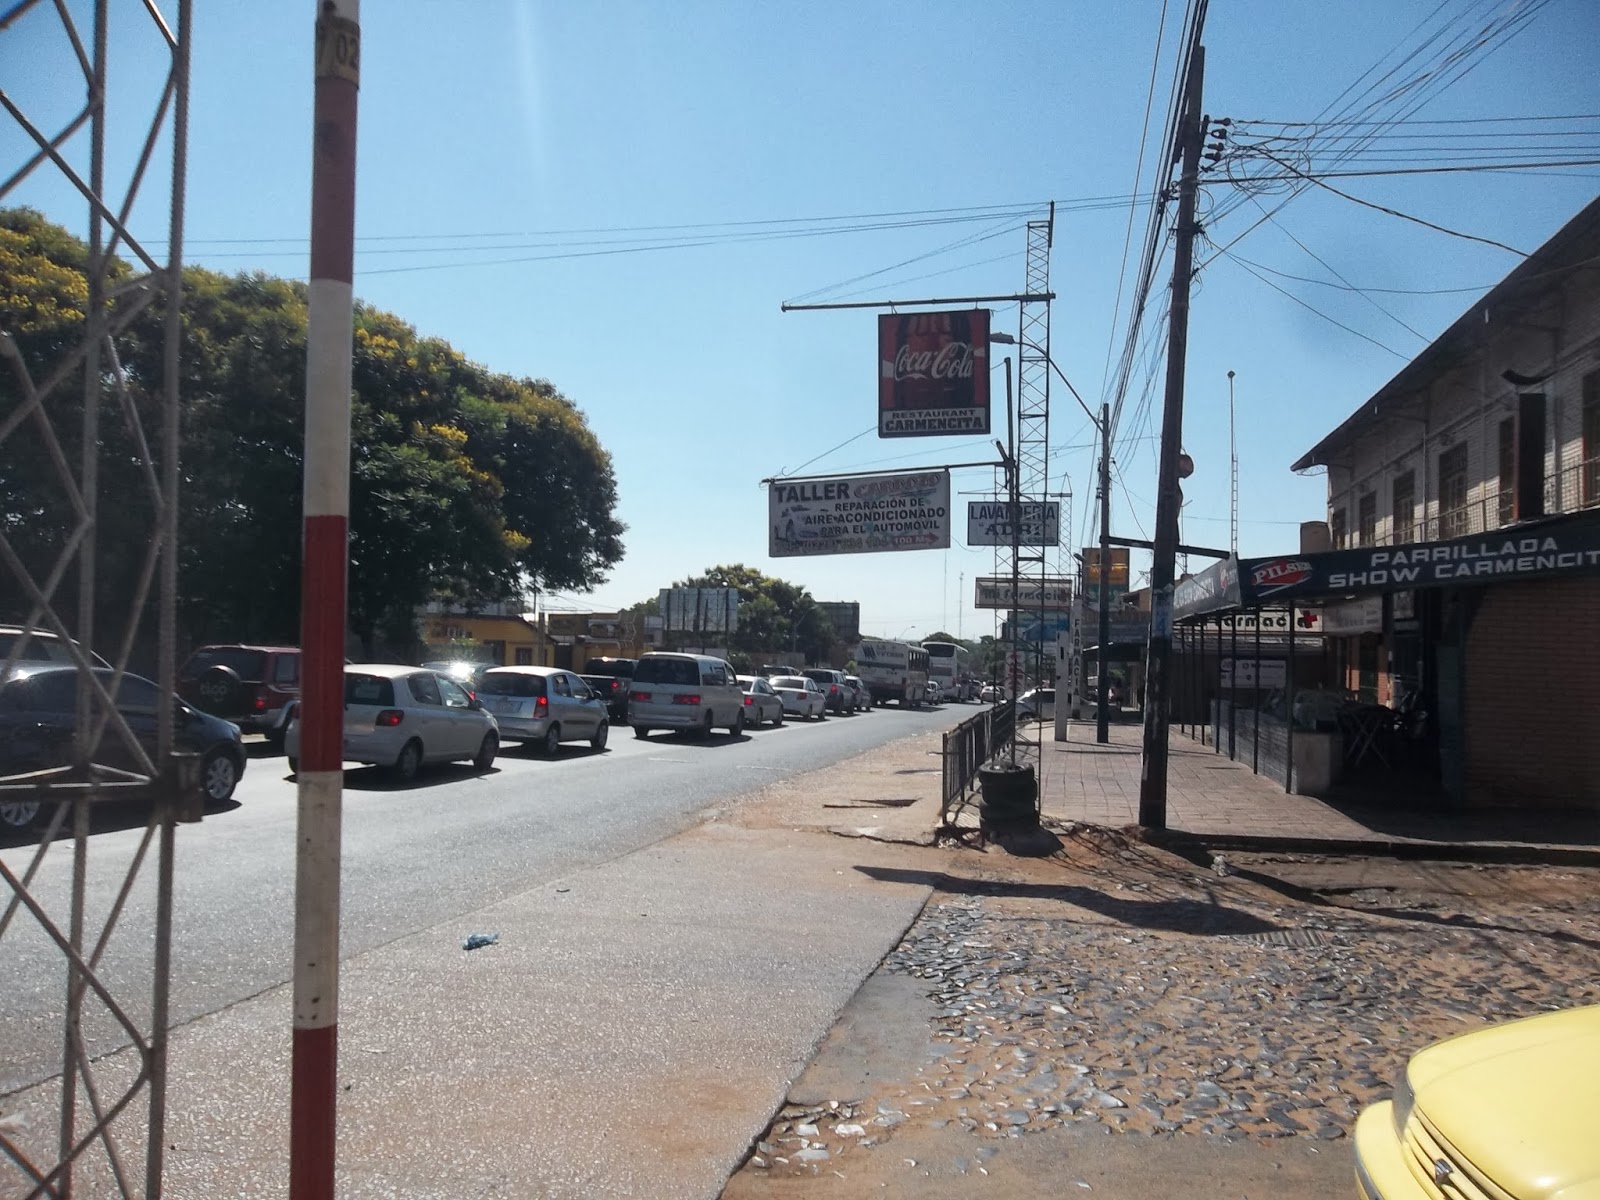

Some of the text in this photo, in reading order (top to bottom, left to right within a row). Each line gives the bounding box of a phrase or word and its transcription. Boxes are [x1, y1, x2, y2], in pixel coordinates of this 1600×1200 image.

[895, 342, 974, 381] Coca-Cola
[892, 409, 975, 419] RESTAURANT
[885, 418, 983, 431] CARMENCITA
[775, 482, 850, 502] TALLER
[835, 497, 926, 512] REPARACIÓN DE
[970, 504, 1056, 521] LAVADERA
[804, 507, 946, 526] AIRE ACONDICIONADO
[821, 520, 940, 536] PARA EL AUTOMÓVIL
[1371, 537, 1558, 567] PARRILLADA
[1328, 550, 1600, 588] SHOW CARMENCIT
[1004, 588, 1070, 600] farmaci
[1073, 619, 1081, 696] FARMACIA
